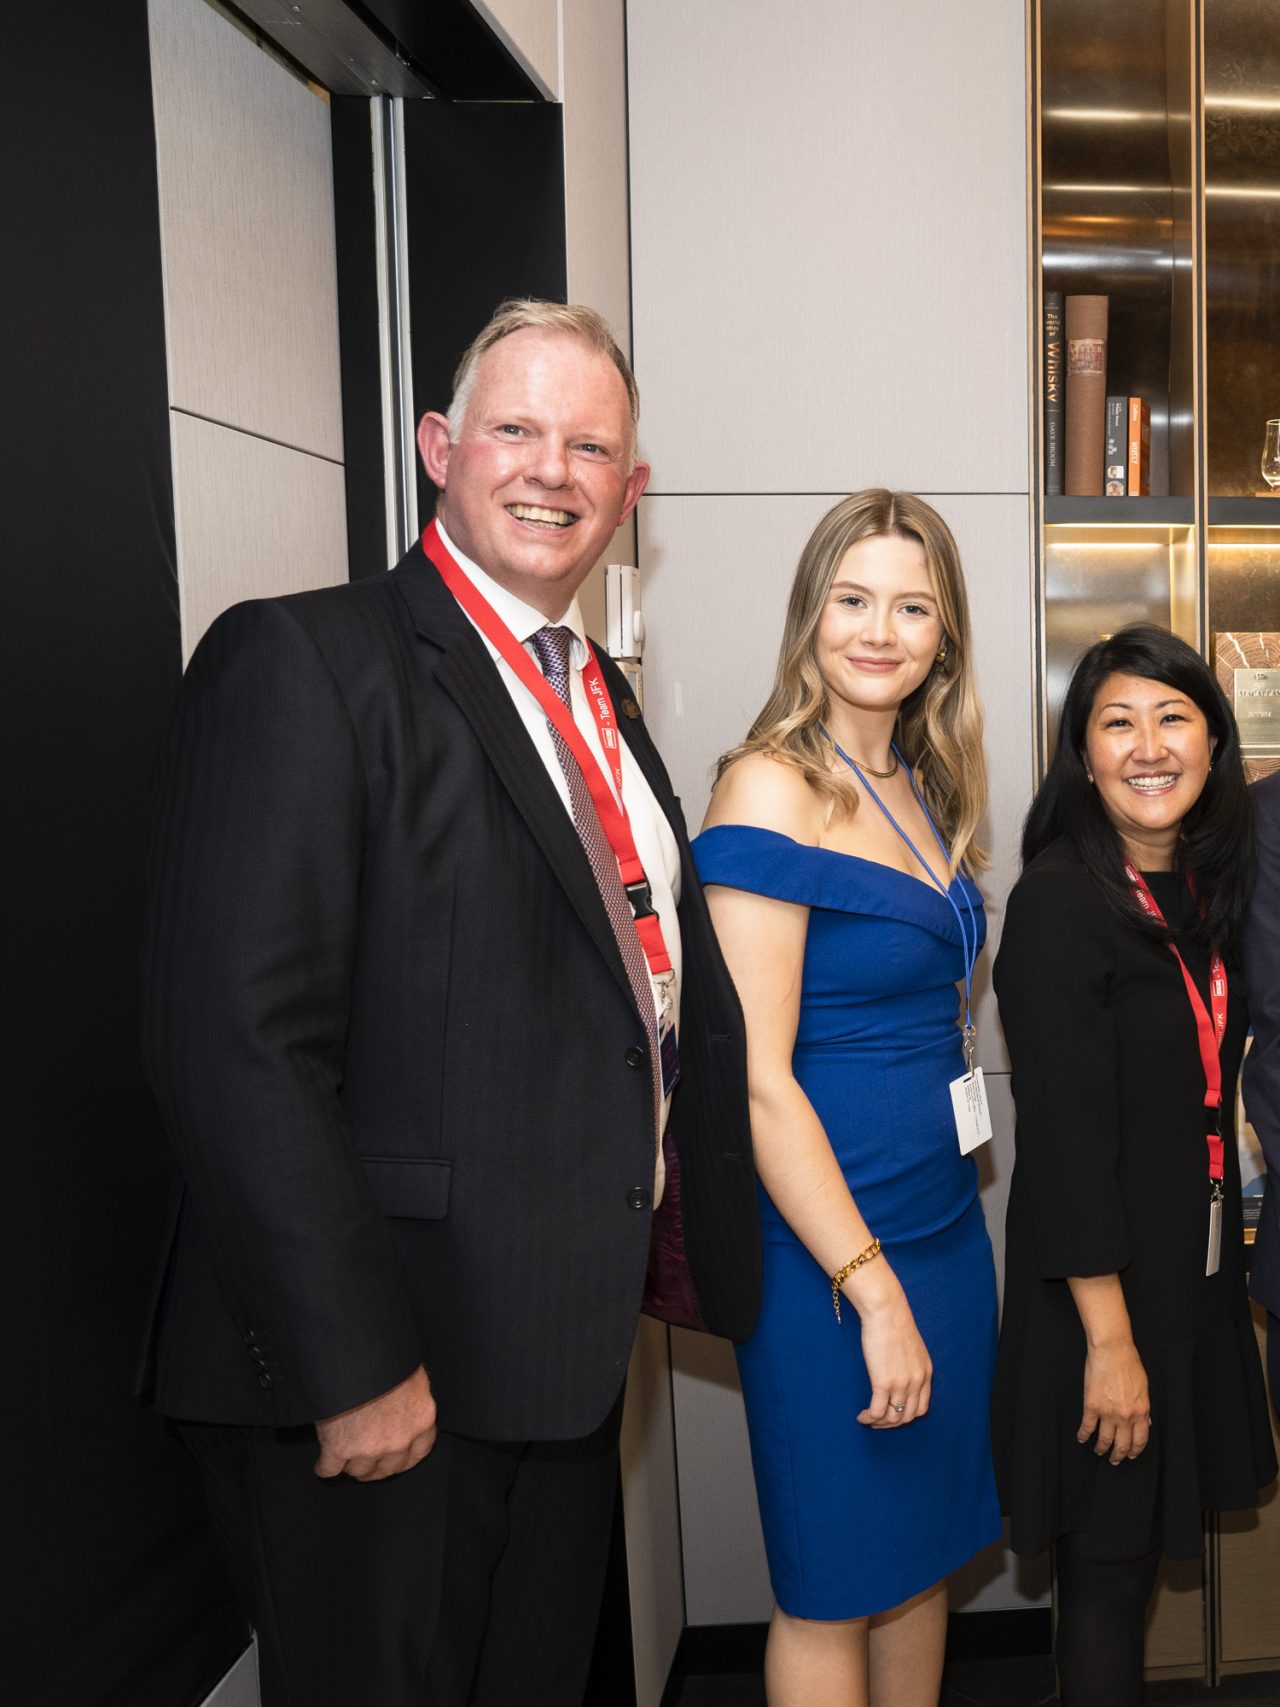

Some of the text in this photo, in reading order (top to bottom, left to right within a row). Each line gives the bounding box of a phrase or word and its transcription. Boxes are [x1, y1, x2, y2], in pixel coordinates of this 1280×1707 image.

[589, 677, 602, 696] JFK
[597, 698, 610, 719] Team
[1216, 1013, 1224, 1029] JFK
